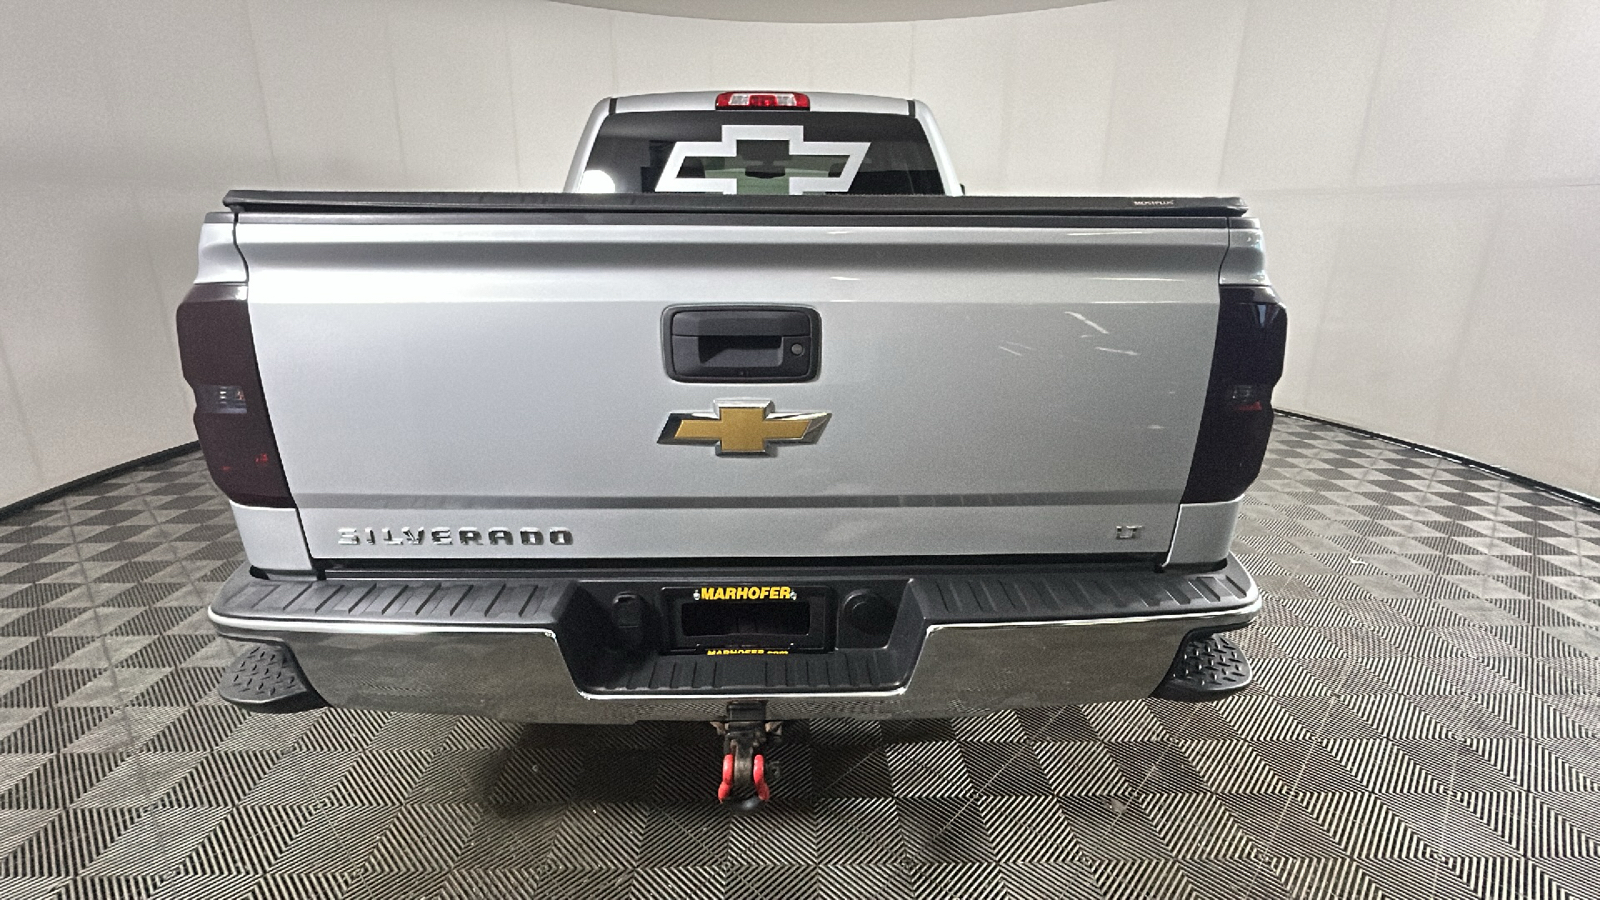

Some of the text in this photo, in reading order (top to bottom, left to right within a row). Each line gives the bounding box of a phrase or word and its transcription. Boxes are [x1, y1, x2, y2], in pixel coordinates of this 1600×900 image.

[337, 526, 574, 545] SILVERADO
[1116, 525, 1143, 540] LT
[701, 586, 791, 600] MARHOFER
